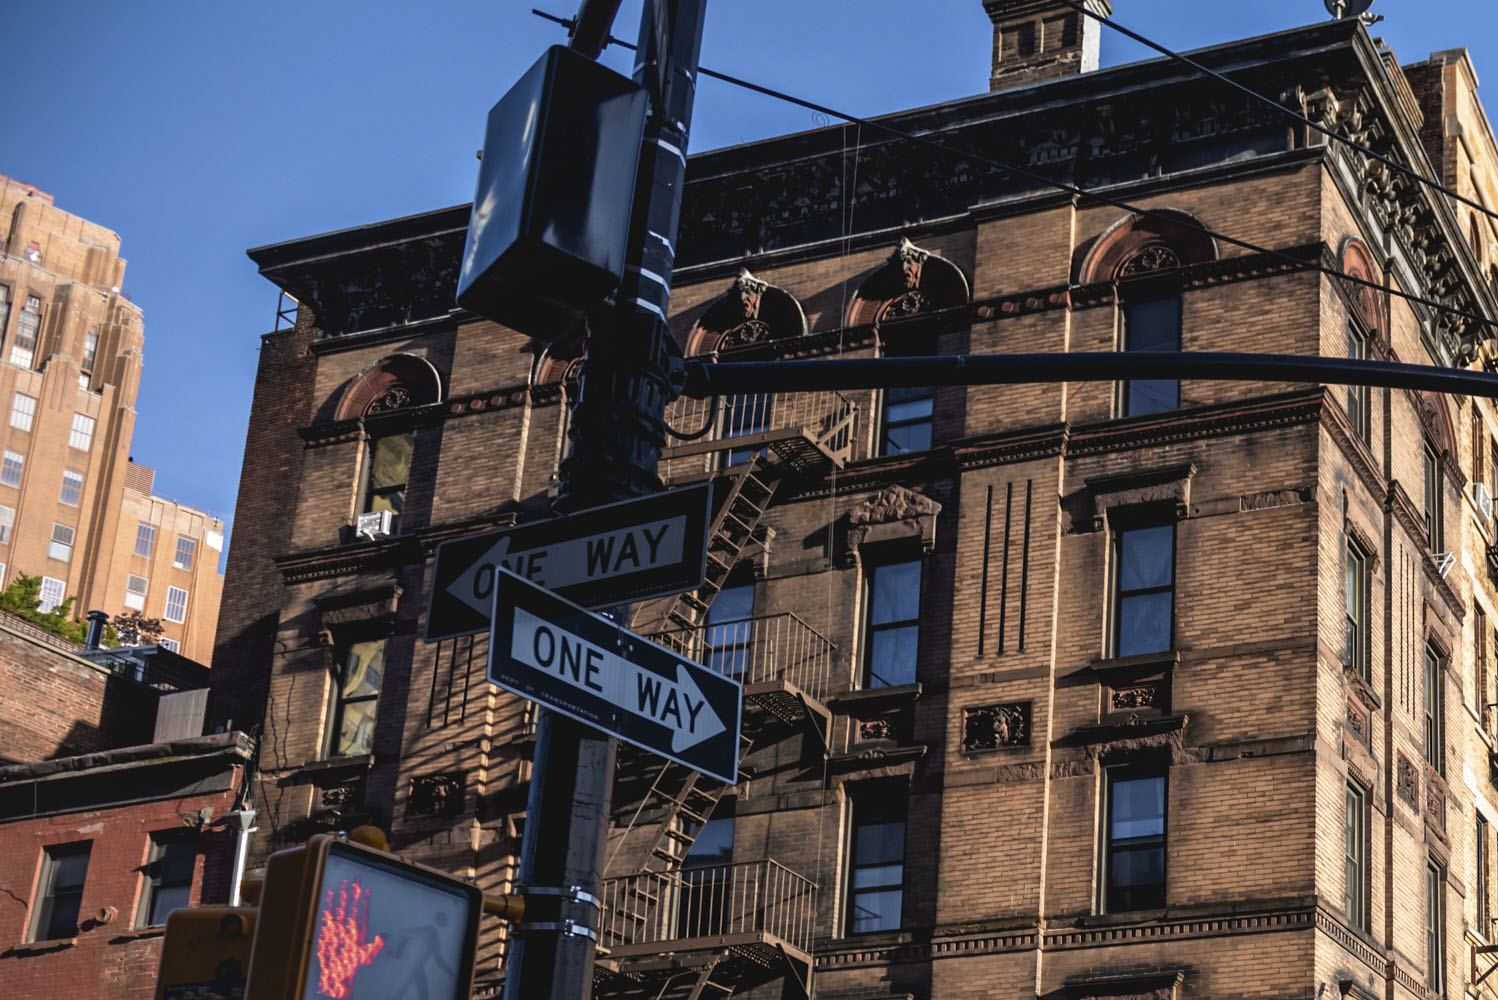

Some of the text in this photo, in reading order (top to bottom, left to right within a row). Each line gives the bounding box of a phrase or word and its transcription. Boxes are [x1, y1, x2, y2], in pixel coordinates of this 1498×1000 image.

[586, 524, 669, 577] WAY
[534, 626, 704, 733] ONE WAY
